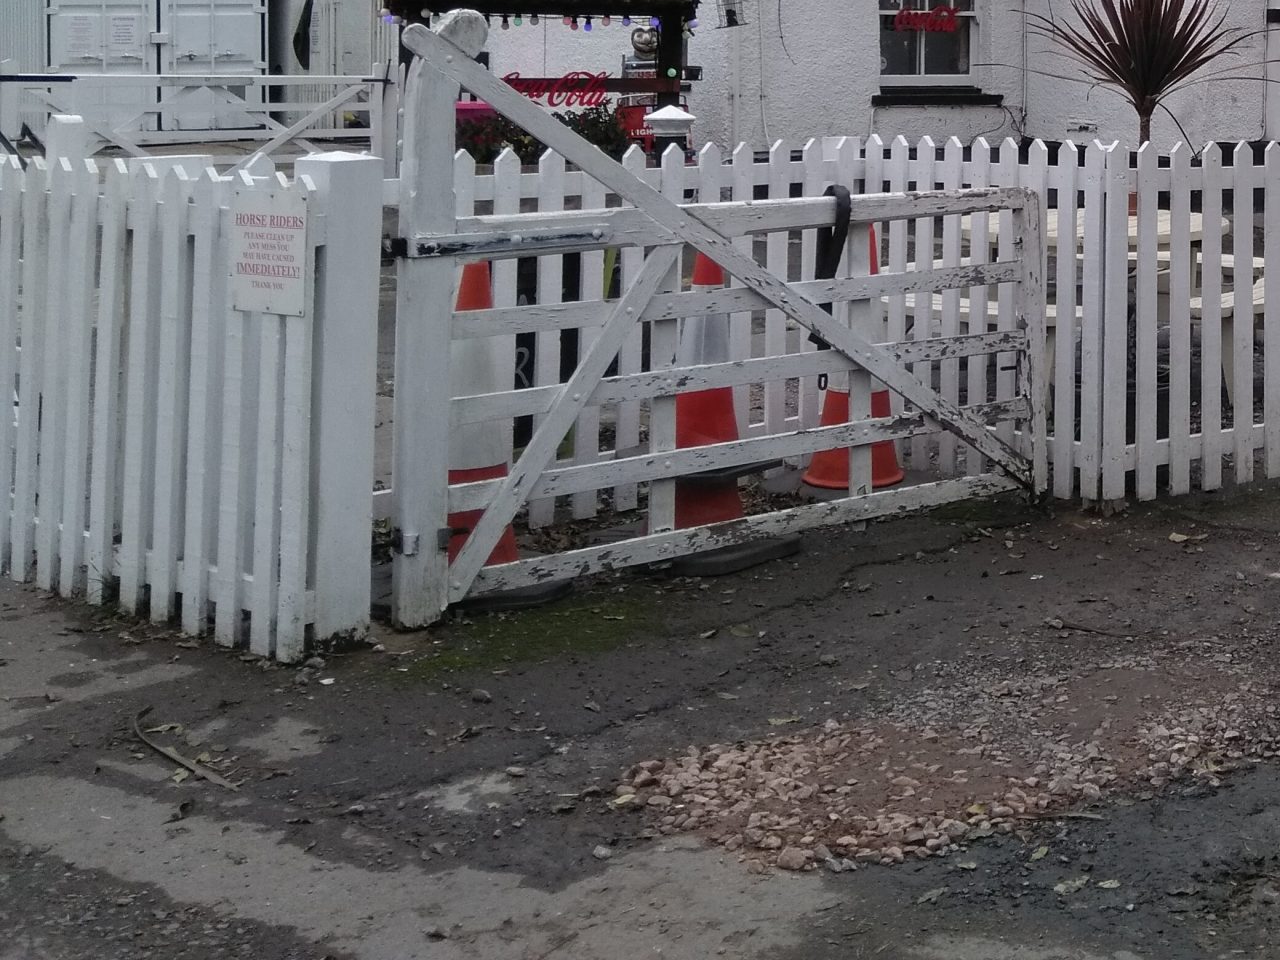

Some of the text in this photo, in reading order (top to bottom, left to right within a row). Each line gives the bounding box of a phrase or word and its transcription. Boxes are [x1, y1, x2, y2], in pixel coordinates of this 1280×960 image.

[235, 213, 304, 228] HORSE RIDERS
[243, 232, 295, 242] PLEASE CLEAN UP
[248, 242, 289, 252] ANY MESS YOU
[256, 252, 271, 261] HAVE
[272, 253, 295, 262] CAUSED
[236, 262, 300, 277] IMMEDIATELY!
[252, 281, 271, 289] THANK
